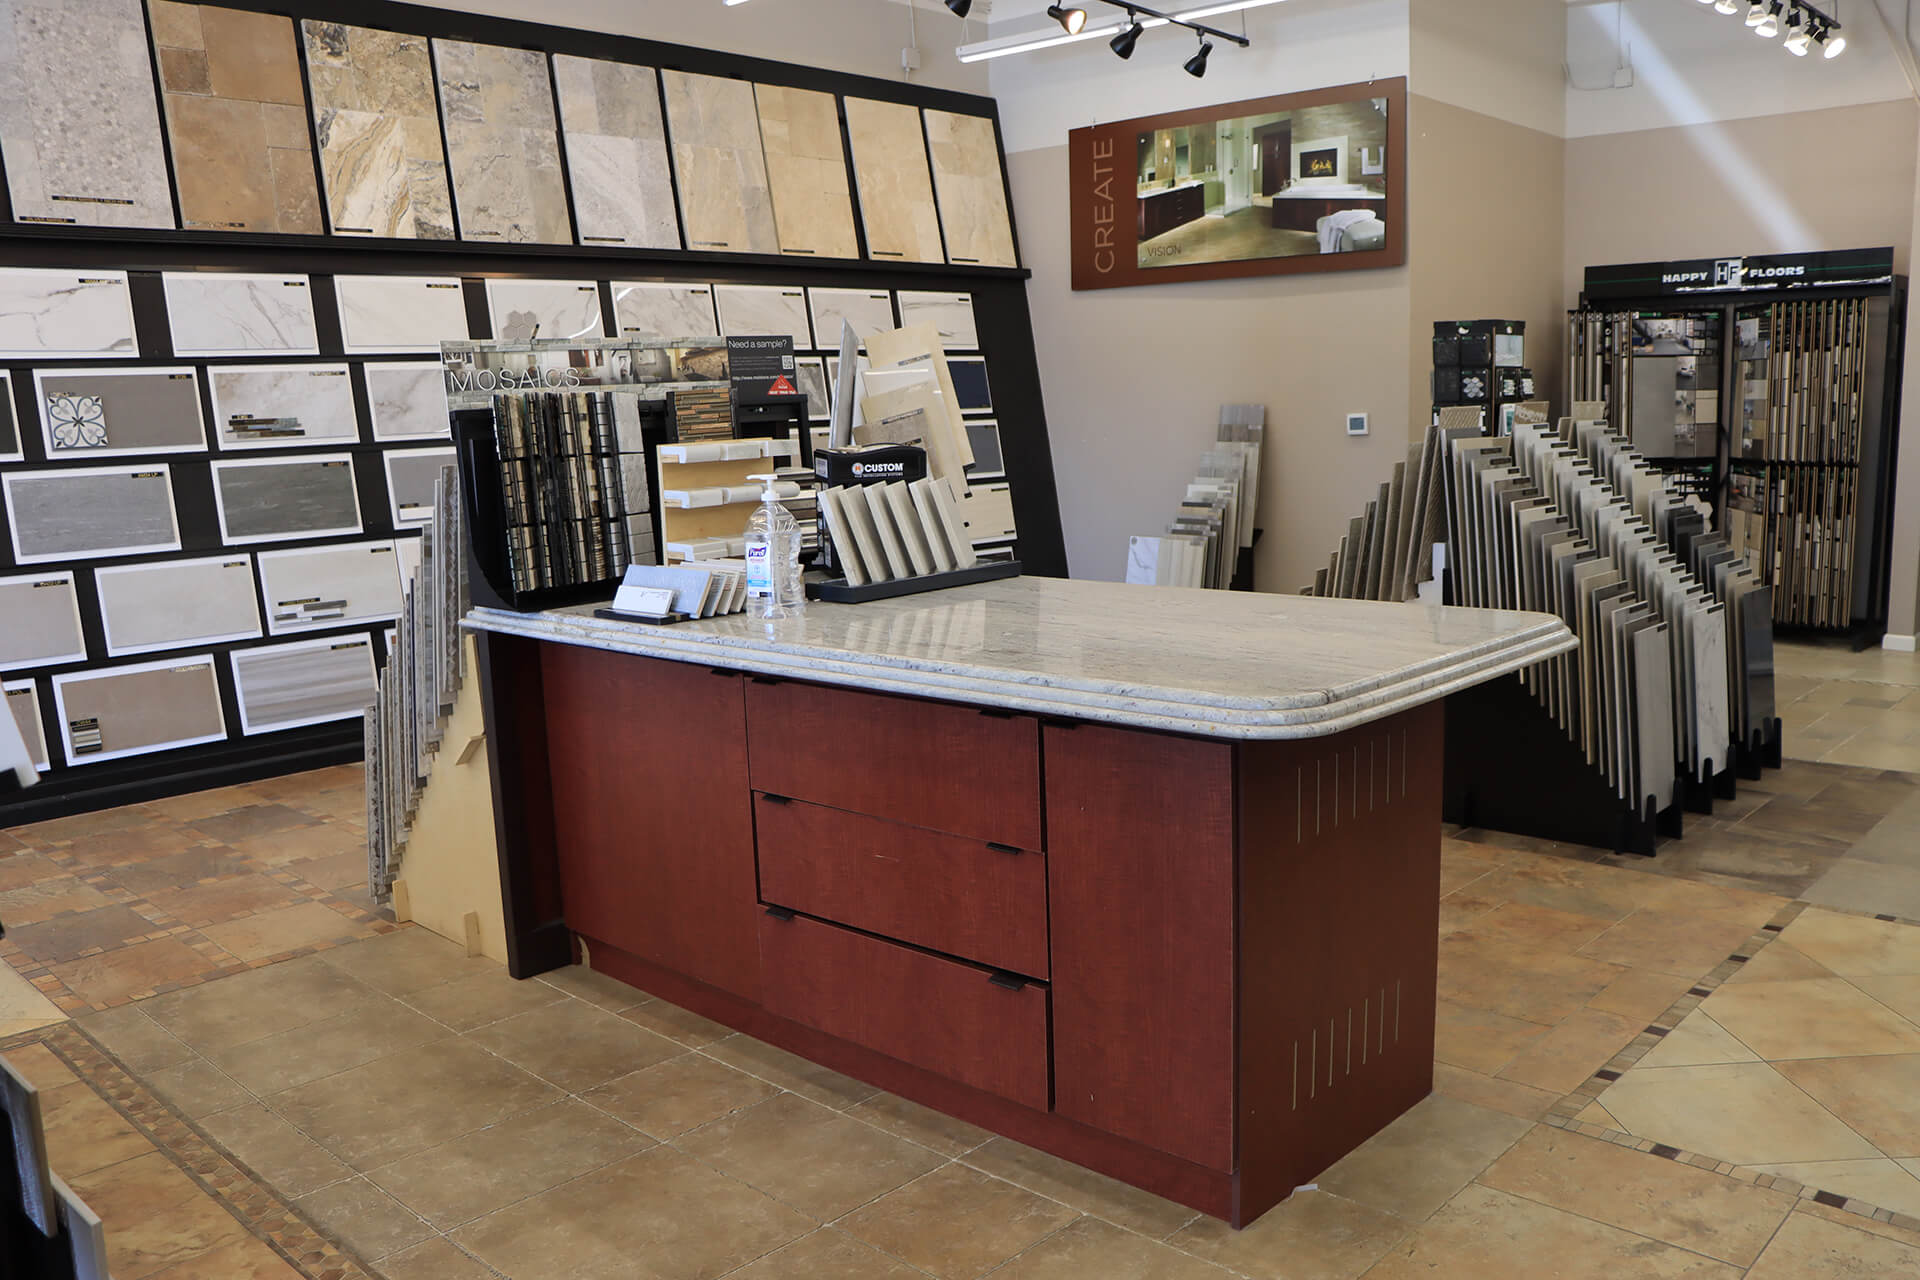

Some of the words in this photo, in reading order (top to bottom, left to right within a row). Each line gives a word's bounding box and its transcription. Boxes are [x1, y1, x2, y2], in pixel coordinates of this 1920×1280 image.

[1094, 138, 1115, 273] CREATE
[1147, 244, 1181, 257] VISION
[1662, 272, 1708, 283] HAPPY
[1750, 266, 1804, 278] FLOORS
[728, 340, 749, 349] Need
[756, 340, 787, 351] sample?
[449, 366, 581, 392] MOSAICS
[864, 463, 904, 473] CUSTOM
